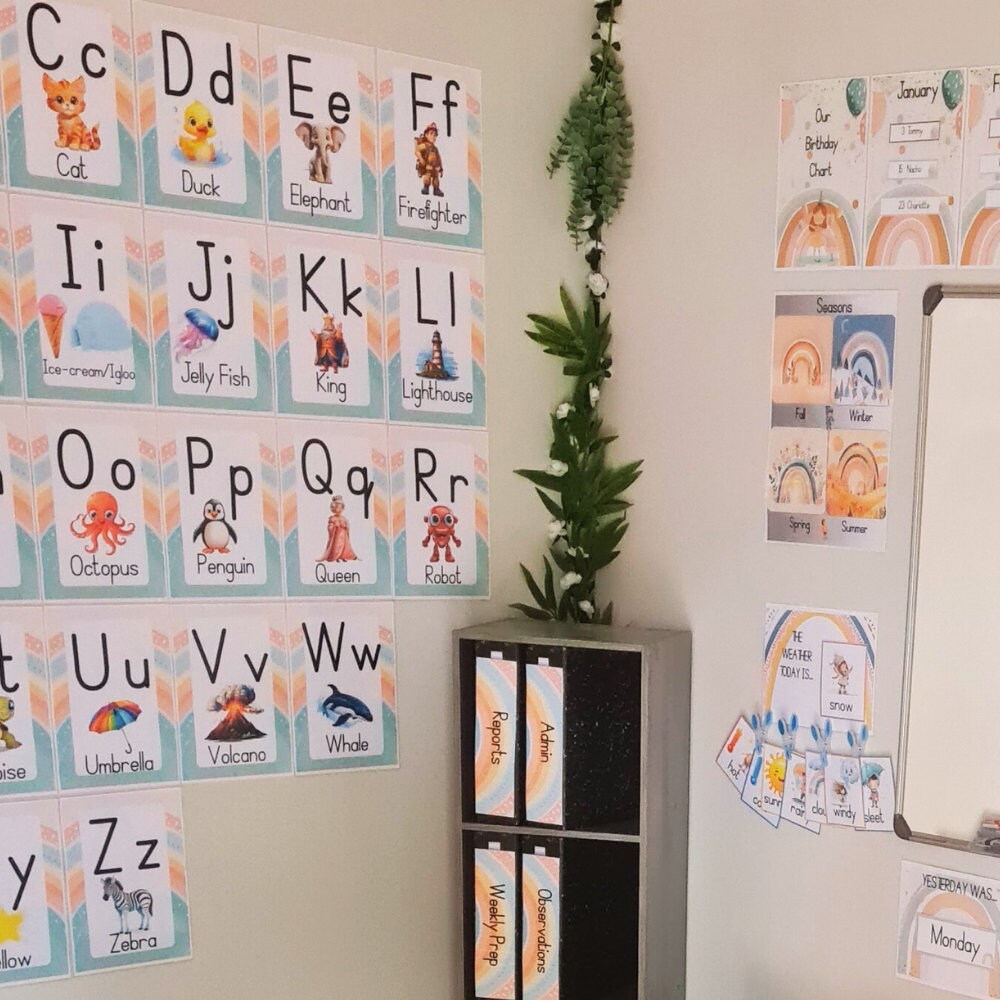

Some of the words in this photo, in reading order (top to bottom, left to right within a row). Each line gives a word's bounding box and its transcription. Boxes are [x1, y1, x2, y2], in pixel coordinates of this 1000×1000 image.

[897, 81, 938, 104] January
[815, 108, 831, 123] Our
[805, 136, 838, 154] Birthday
[56, 153, 88, 180] Cat
[810, 163, 832, 177] Chart
[182, 170, 221, 197] Duck
[290, 183, 352, 216] Elephant
[398, 196, 467, 230] Firefighter
[817, 298, 853, 313] Seasons
[43, 358, 136, 385] Ice-cream/Igloo
[181, 362, 214, 393] Jelly
[219, 364, 250, 388] Fish
[316, 372, 347, 402] King
[402, 378, 473, 407] Lighthouse
[795, 408, 806, 419] Fall
[849, 409, 873, 422] Winter
[789, 517, 810, 533] Spring
[841, 520, 868, 533] Summer
[70, 554, 139, 584] Octopus
[197, 557, 255, 583] Penguin
[315, 563, 361, 584] Queen
[425, 565, 462, 585] Robot
[793, 630, 803, 643] THE
[782, 648, 813, 662] WEATHER
[780, 666, 800, 678] TODAY
[829, 701, 853, 712] snow
[326, 735, 369, 754] Whale
[486, 710, 508, 765] Reports
[540, 721, 555, 763] Admin
[85, 755, 154, 775] Umbrella
[208, 745, 267, 765] Volcano
[727, 760, 741, 782] hot
[833, 806, 857, 826] windy
[863, 811, 885, 824] sleet
[922, 872, 968, 899] YESTERDAY
[482, 884, 506, 933] Weekly
[536, 888, 553, 973] Observations
[109, 932, 157, 954] Zebra
[489, 934, 506, 967] Prep
[930, 923, 981, 963] Monday
